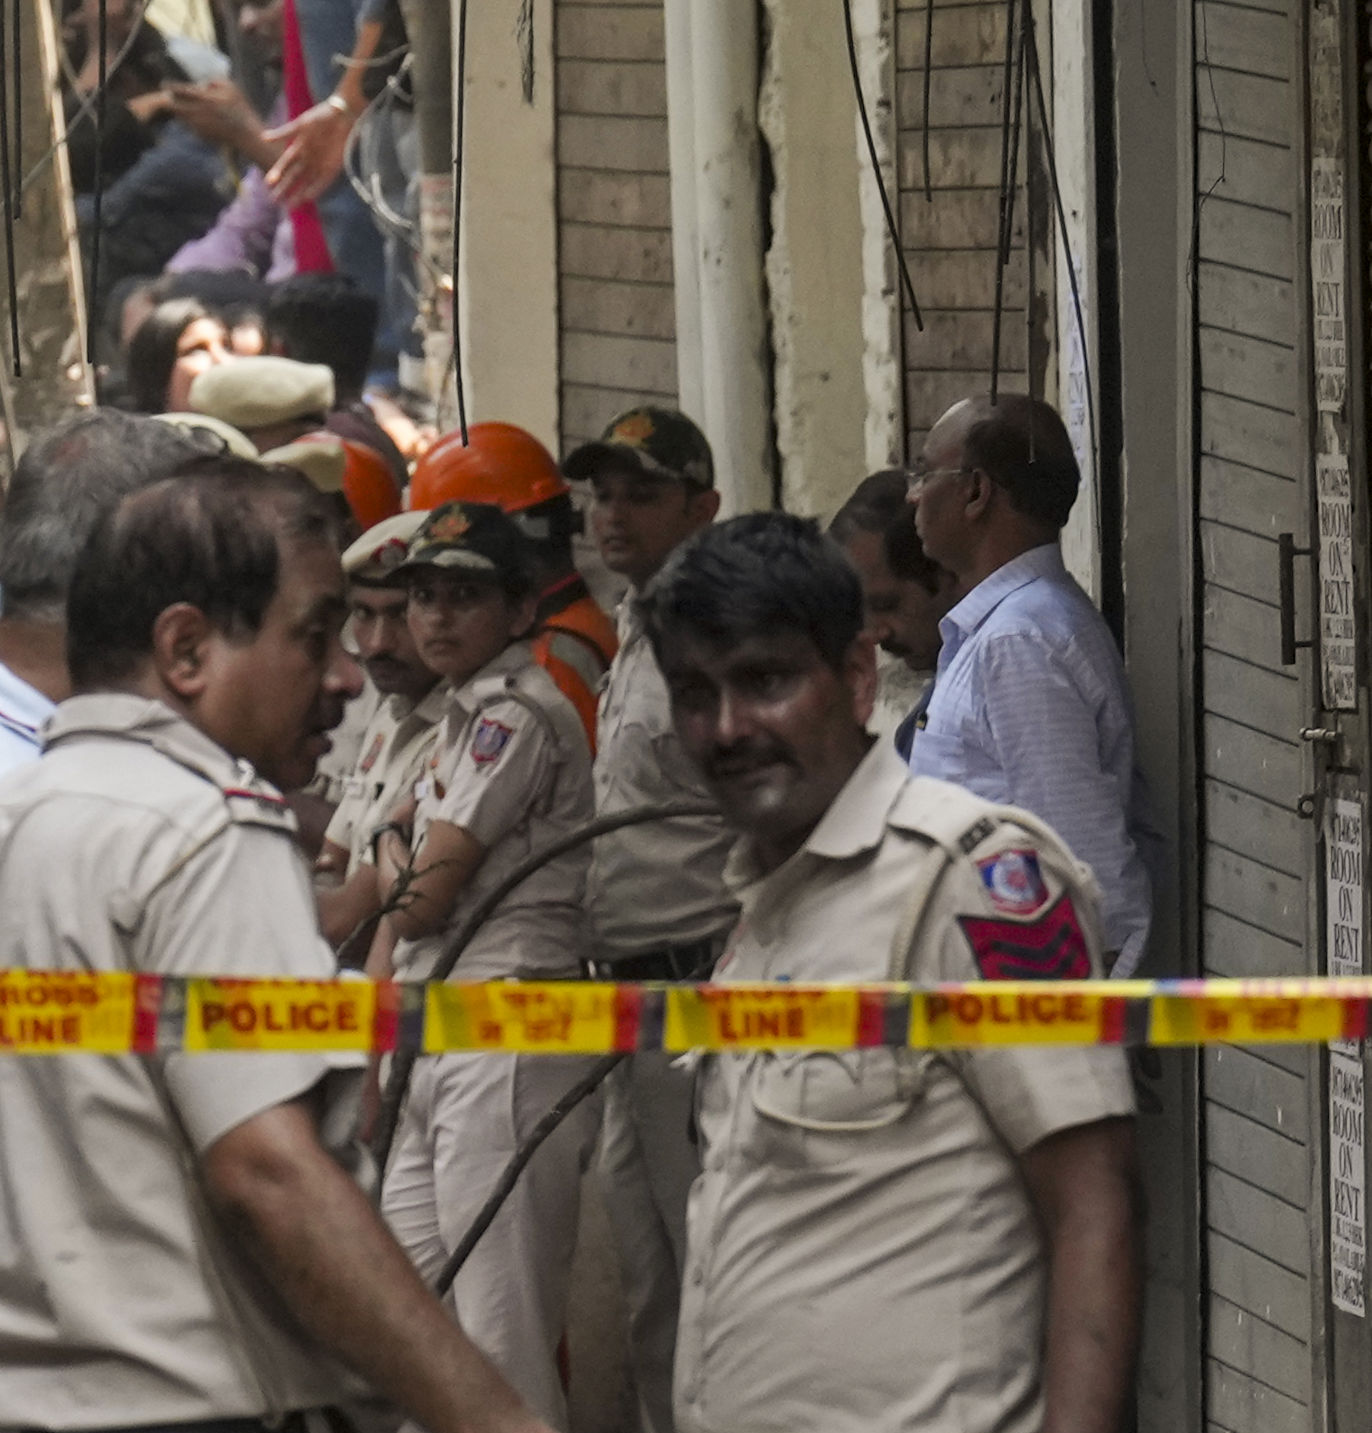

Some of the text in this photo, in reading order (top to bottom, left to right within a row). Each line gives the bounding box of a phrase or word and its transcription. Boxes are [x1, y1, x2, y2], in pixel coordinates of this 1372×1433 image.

[1331, 846, 1360, 886] ROOM
[1339, 885, 1353, 921] ON
[1334, 923, 1359, 962] RENT
[202, 1001, 360, 1033] POLICE
[716, 1007, 804, 1042] LINE
[925, 996, 1088, 1026] POLICE
[1333, 1100, 1362, 1147] ROOM
[1339, 1142, 1353, 1179] ON
[1334, 1178, 1360, 1222] RENT
